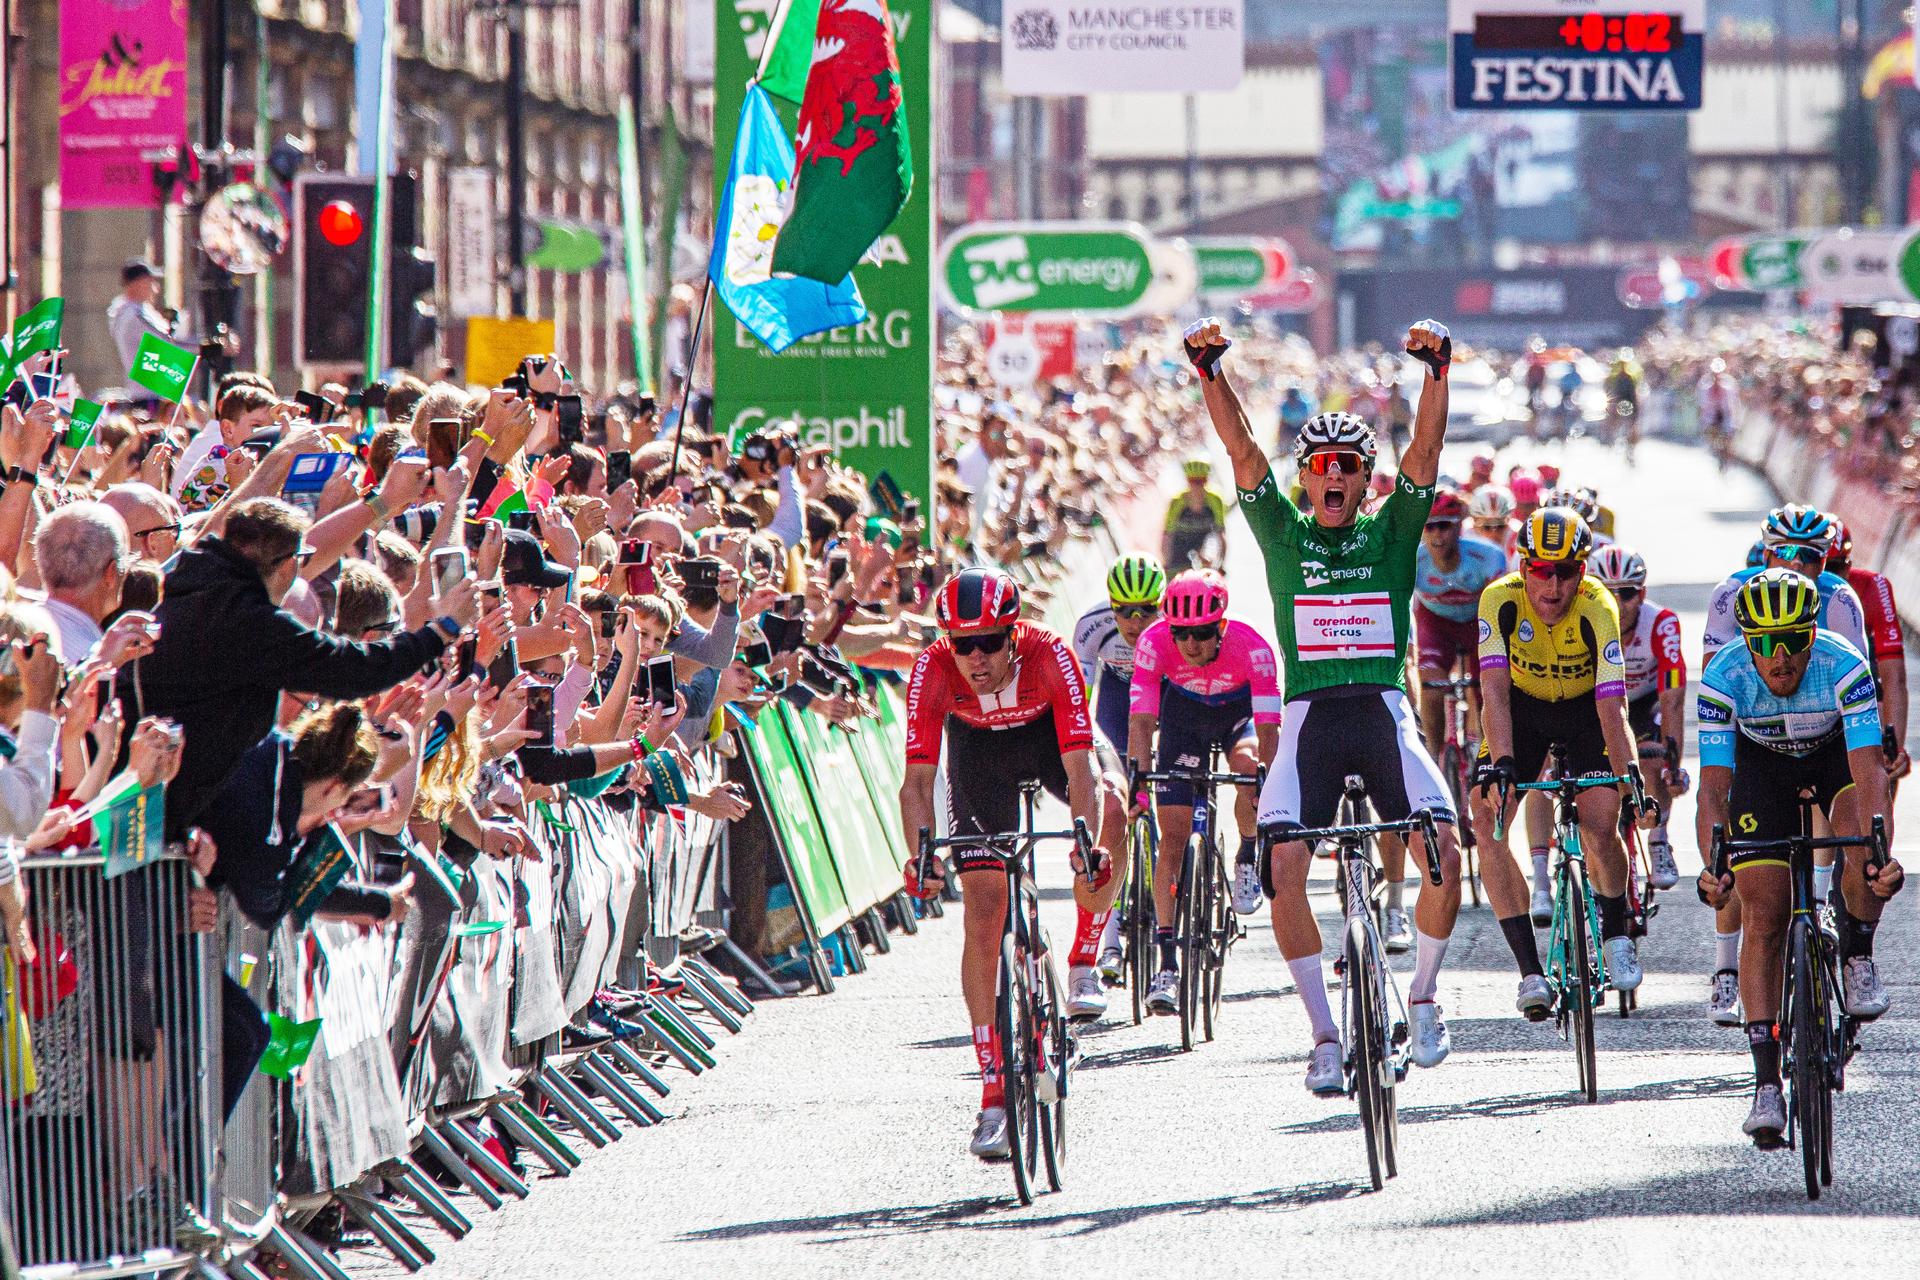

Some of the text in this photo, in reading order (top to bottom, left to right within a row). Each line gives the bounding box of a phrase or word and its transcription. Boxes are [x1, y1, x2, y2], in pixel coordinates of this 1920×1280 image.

[1068, 7, 1235, 30] MANCHESTER
[1067, 33, 1188, 49] CITY COUNCIL
[1472, 58, 1684, 101] FESTINA
[1038, 256, 1142, 293] energy
[735, 309, 912, 348] EERG
[758, 347, 816, 358] ALOHOL
[159, 364, 186, 383] energy
[70, 419, 91, 431] nergy
[1547, 524, 1560, 545] MIKE
[1303, 539, 1314, 550] LE
[1315, 545, 1331, 556] CO
[1331, 566, 1373, 580] energy
[1321, 628, 1362, 637] Circus
[1052, 642, 1084, 706] sunweb
[908, 653, 930, 720] sunweb
[1844, 680, 1875, 703] Cetap
[1697, 704, 1727, 720] taphil
[1701, 734, 1729, 745] COL
[960, 849, 994, 859] SAMS
